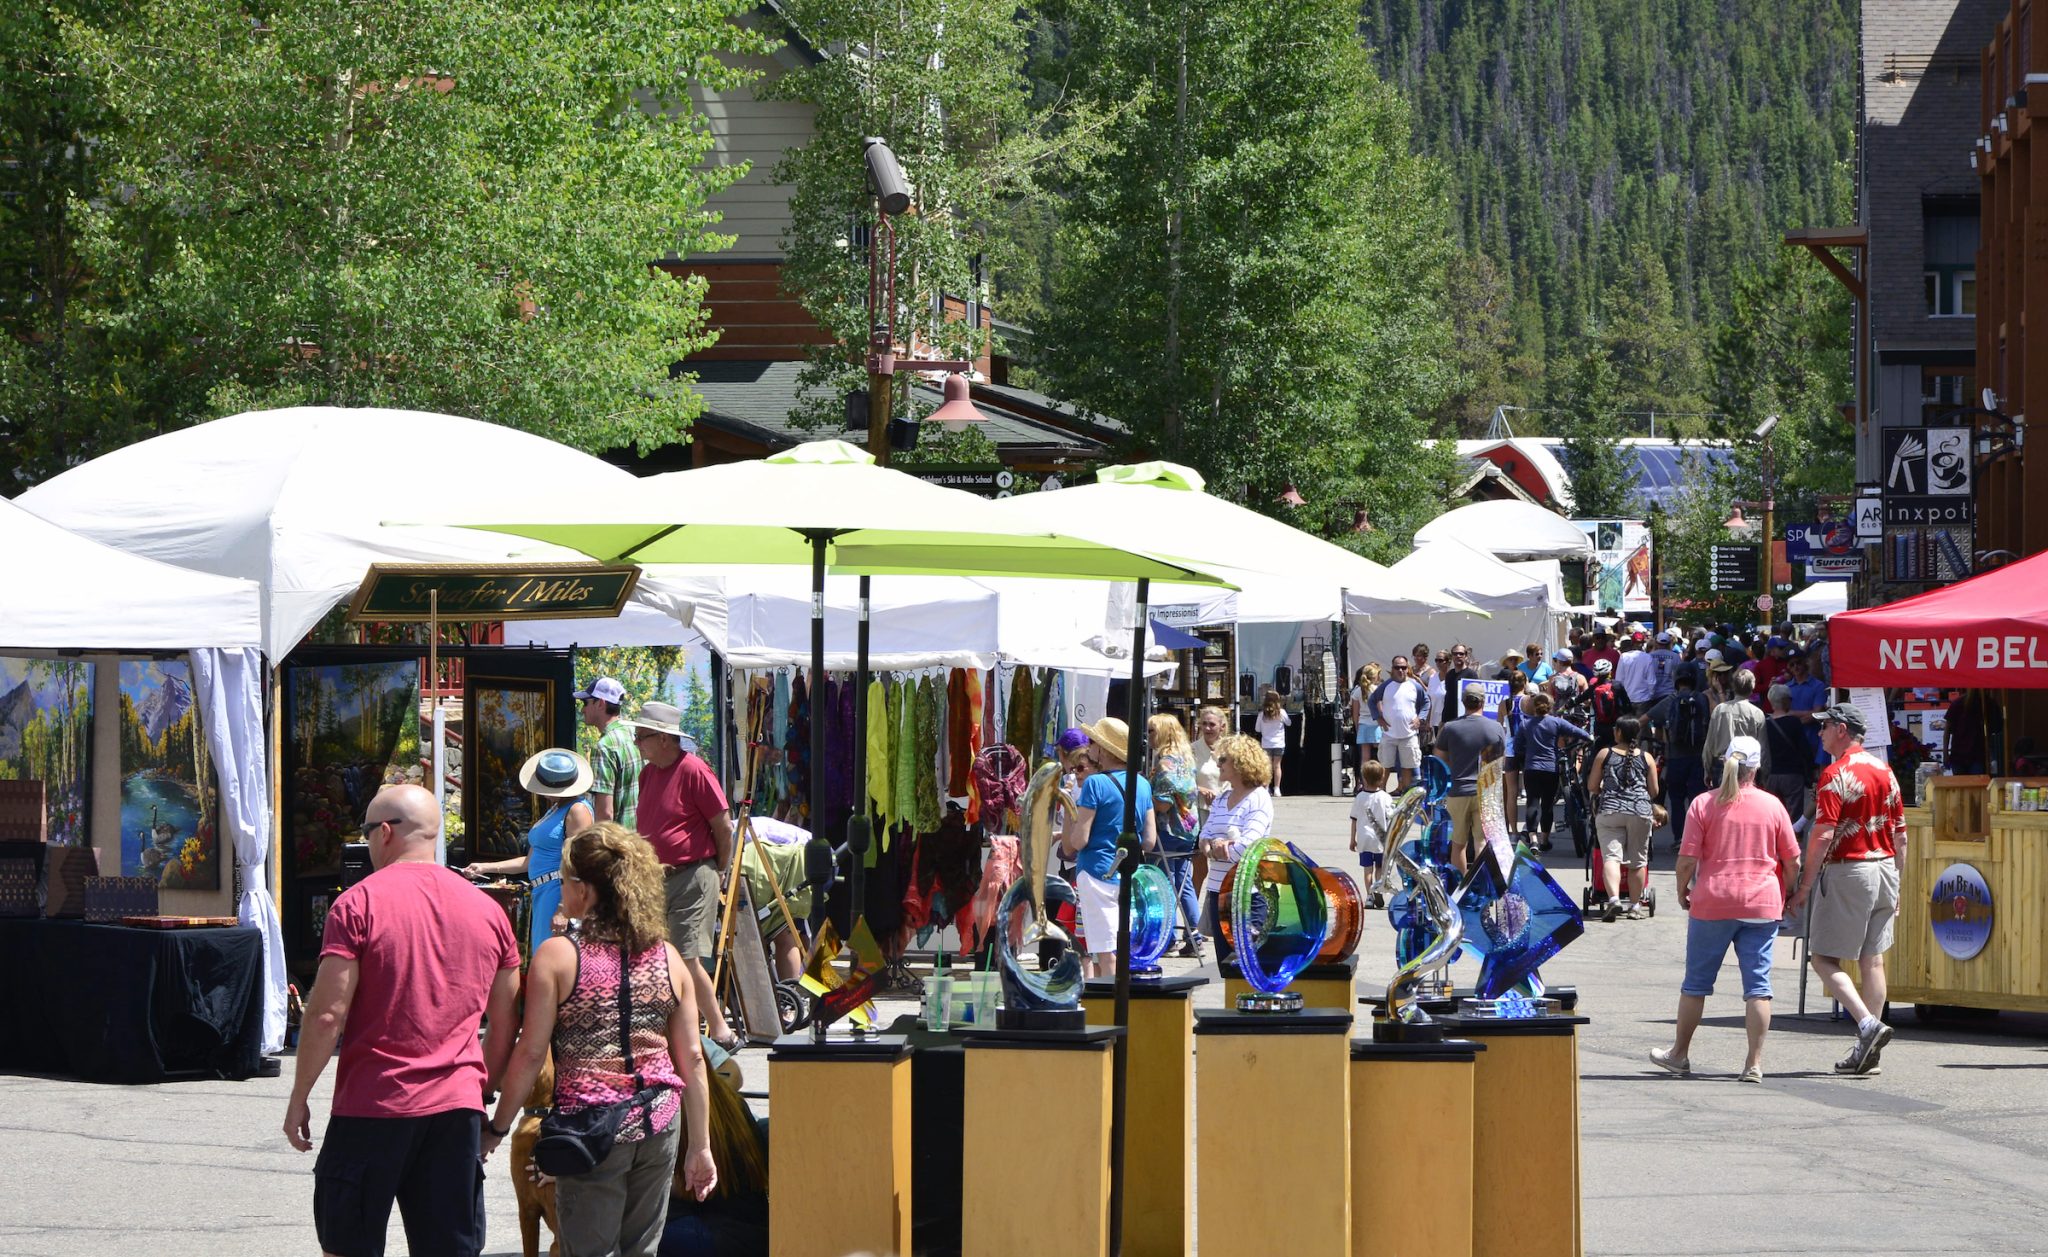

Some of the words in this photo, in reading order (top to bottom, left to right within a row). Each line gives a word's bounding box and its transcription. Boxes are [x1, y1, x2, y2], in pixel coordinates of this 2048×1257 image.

[962, 474, 975, 484] Ride
[975, 474, 993, 484] School
[1888, 501, 1968, 525] inxpot
[1815, 558, 1861, 568] Surefoot
[1157, 608, 1199, 620] Impressionist
[1879, 638, 1964, 670] NEW
[1975, 636, 2048, 669] BEL
[1937, 879, 1954, 904] JIM
[1956, 874, 1983, 901] BEAM
